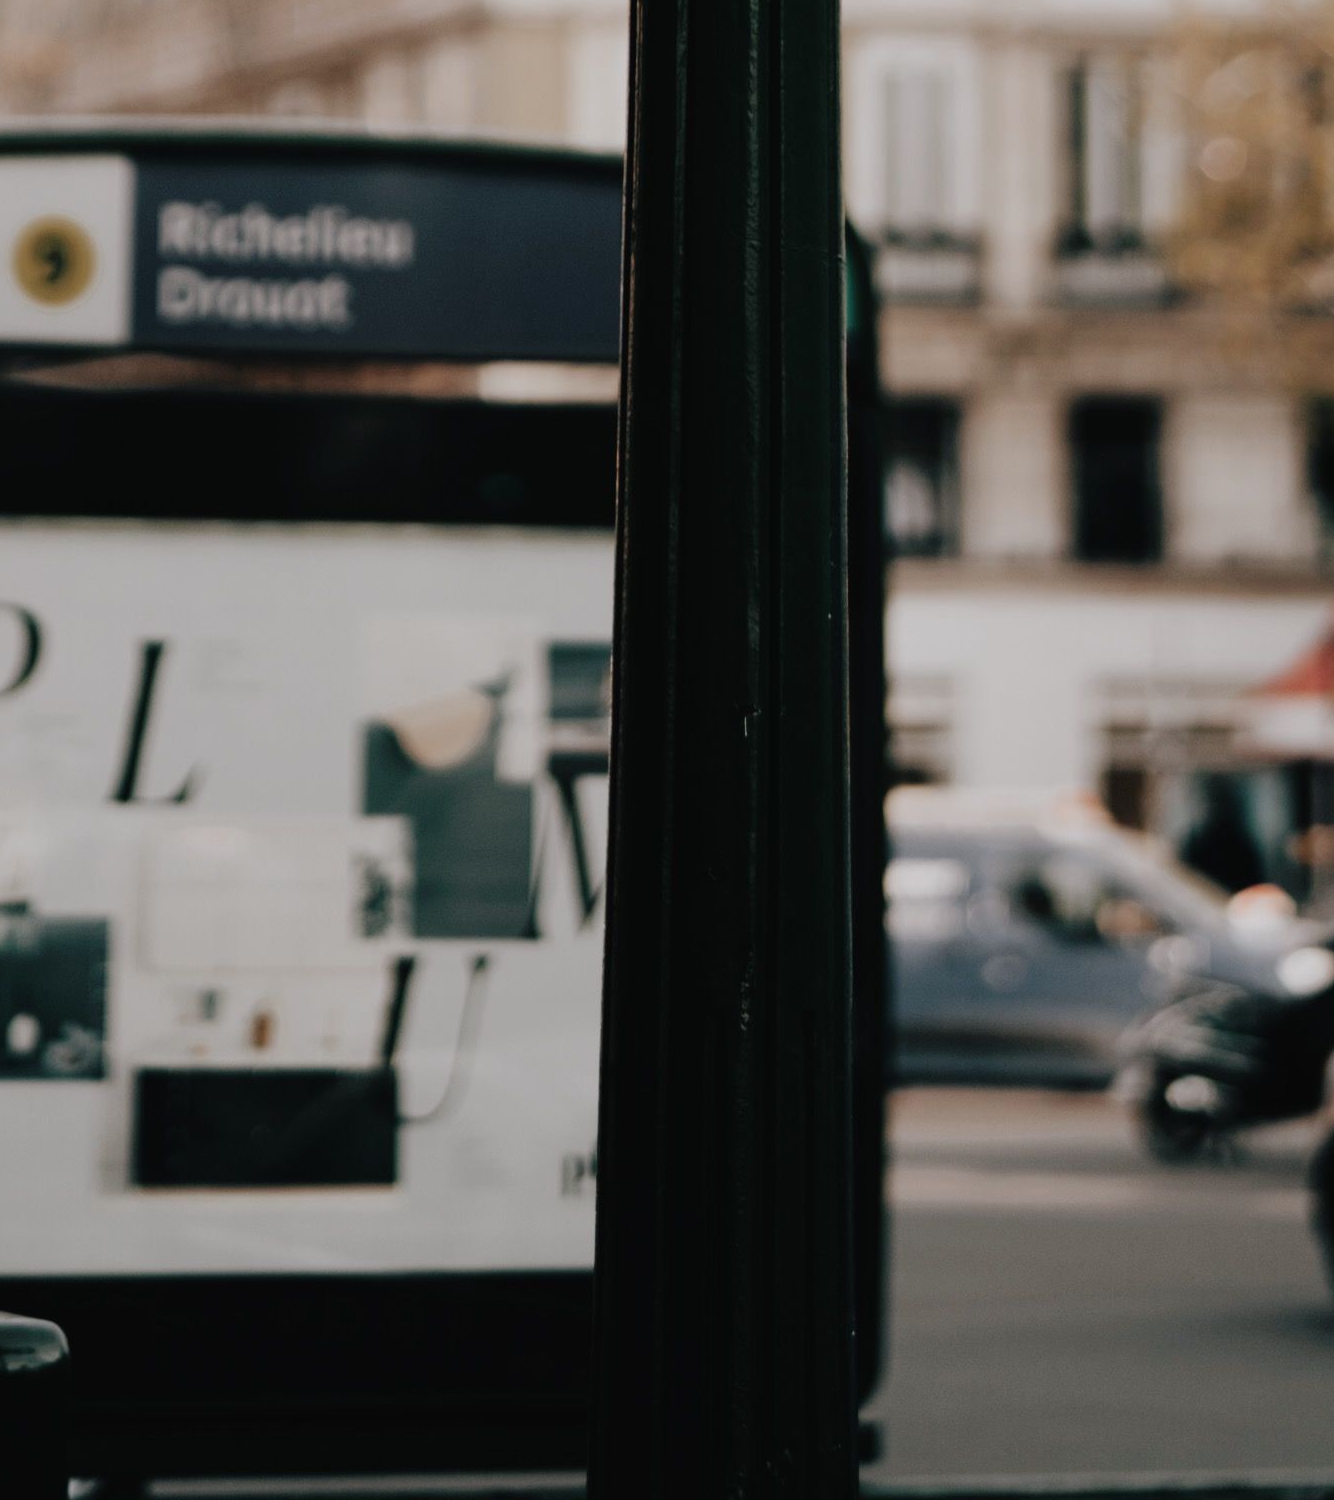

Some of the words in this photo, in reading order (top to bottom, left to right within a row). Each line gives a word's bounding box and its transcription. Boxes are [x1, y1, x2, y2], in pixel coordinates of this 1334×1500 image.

[33, 231, 69, 284] 9
[159, 202, 414, 267] Richelieu
[107, 640, 209, 805] L
